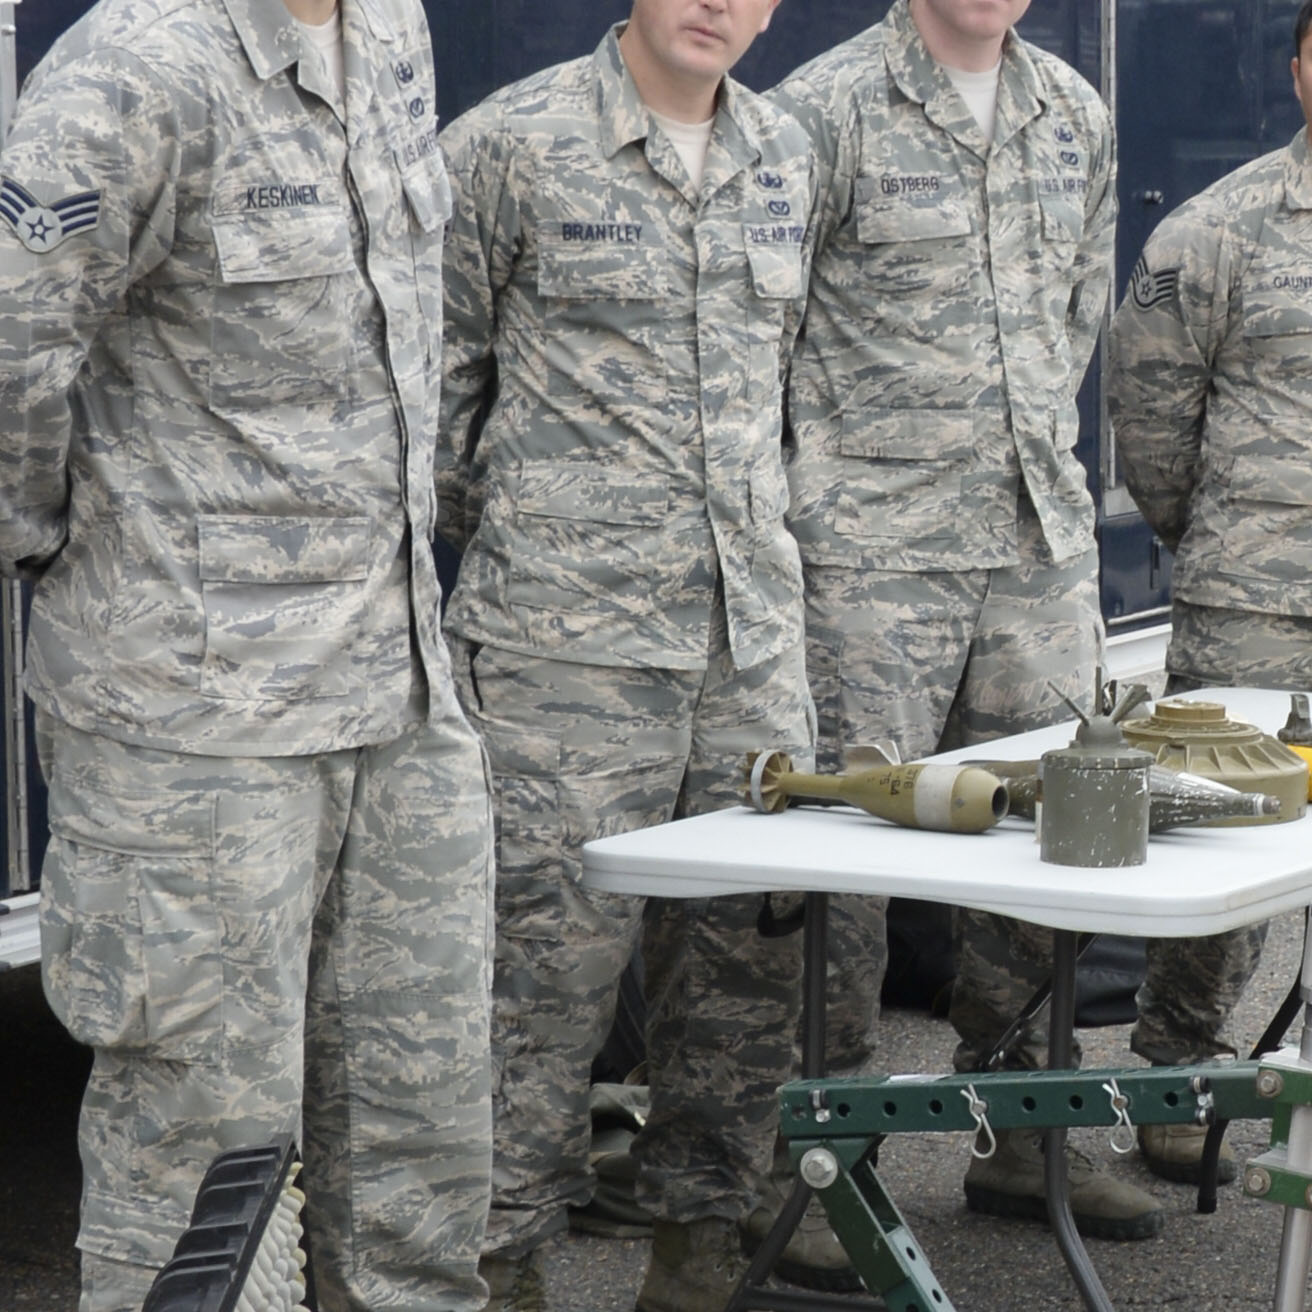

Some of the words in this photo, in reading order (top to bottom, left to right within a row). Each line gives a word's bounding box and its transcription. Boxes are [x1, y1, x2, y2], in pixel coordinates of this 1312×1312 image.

[881, 176, 940, 194] OSTBERG
[246, 184, 320, 209] KESKINEN
[562, 223, 643, 241] BRANTLEY
[1273, 275, 1312, 289] GAUNT
